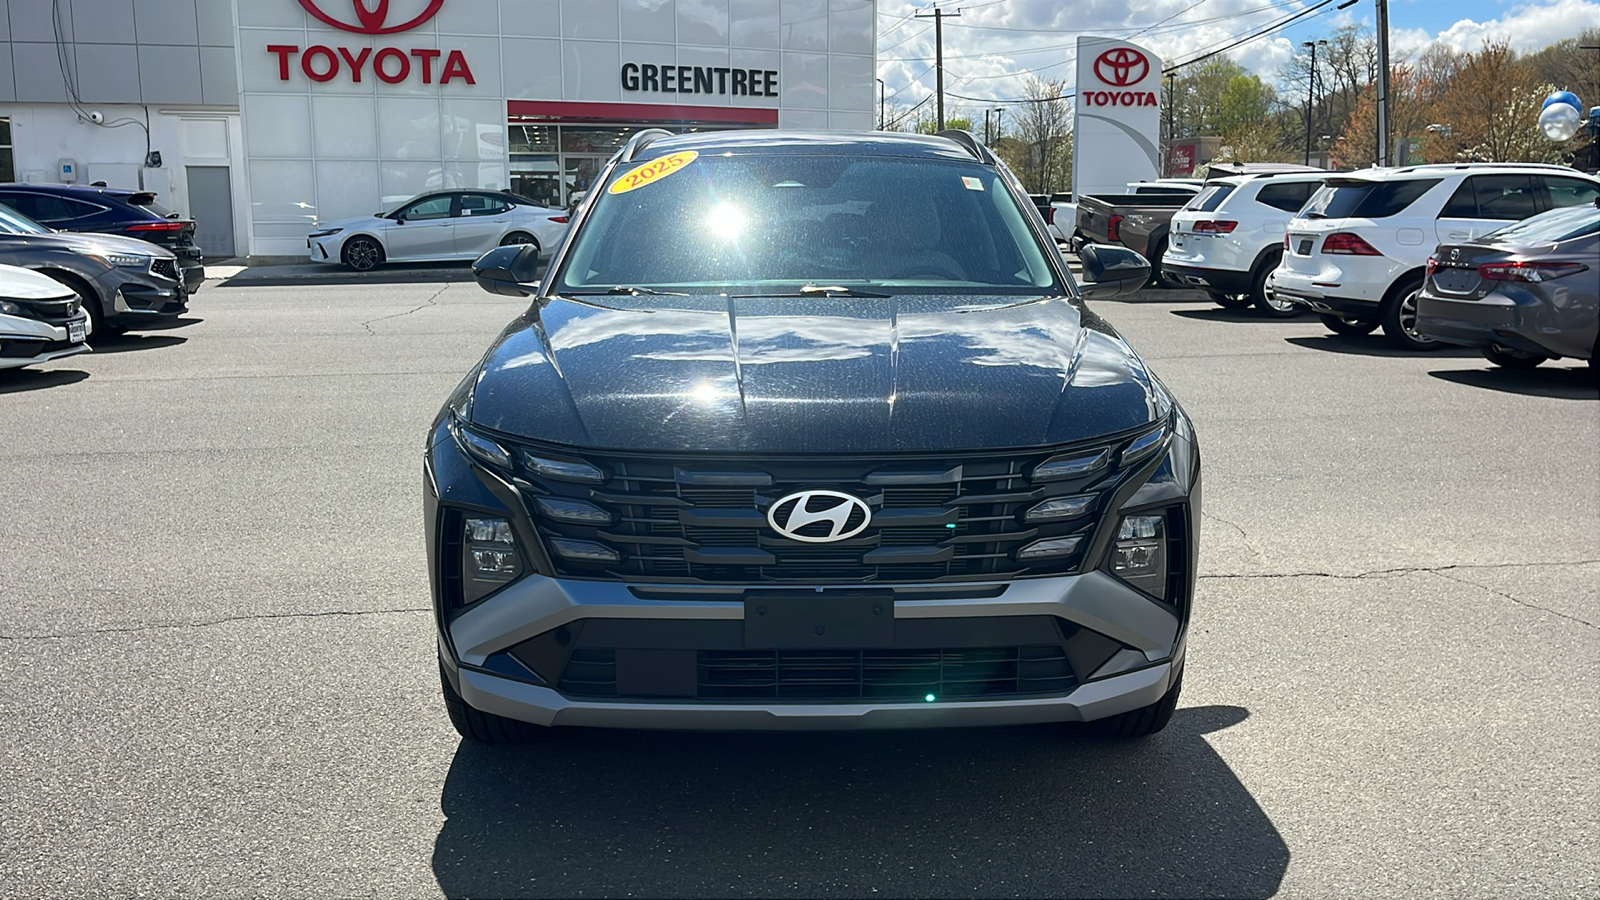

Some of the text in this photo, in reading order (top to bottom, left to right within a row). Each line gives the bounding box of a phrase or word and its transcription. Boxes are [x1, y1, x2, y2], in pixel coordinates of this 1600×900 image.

[267, 45, 476, 85] TOYOTA
[621, 63, 778, 97] GREENTREE
[1082, 91, 1158, 107] TOYOTA
[626, 155, 684, 187] 2025
